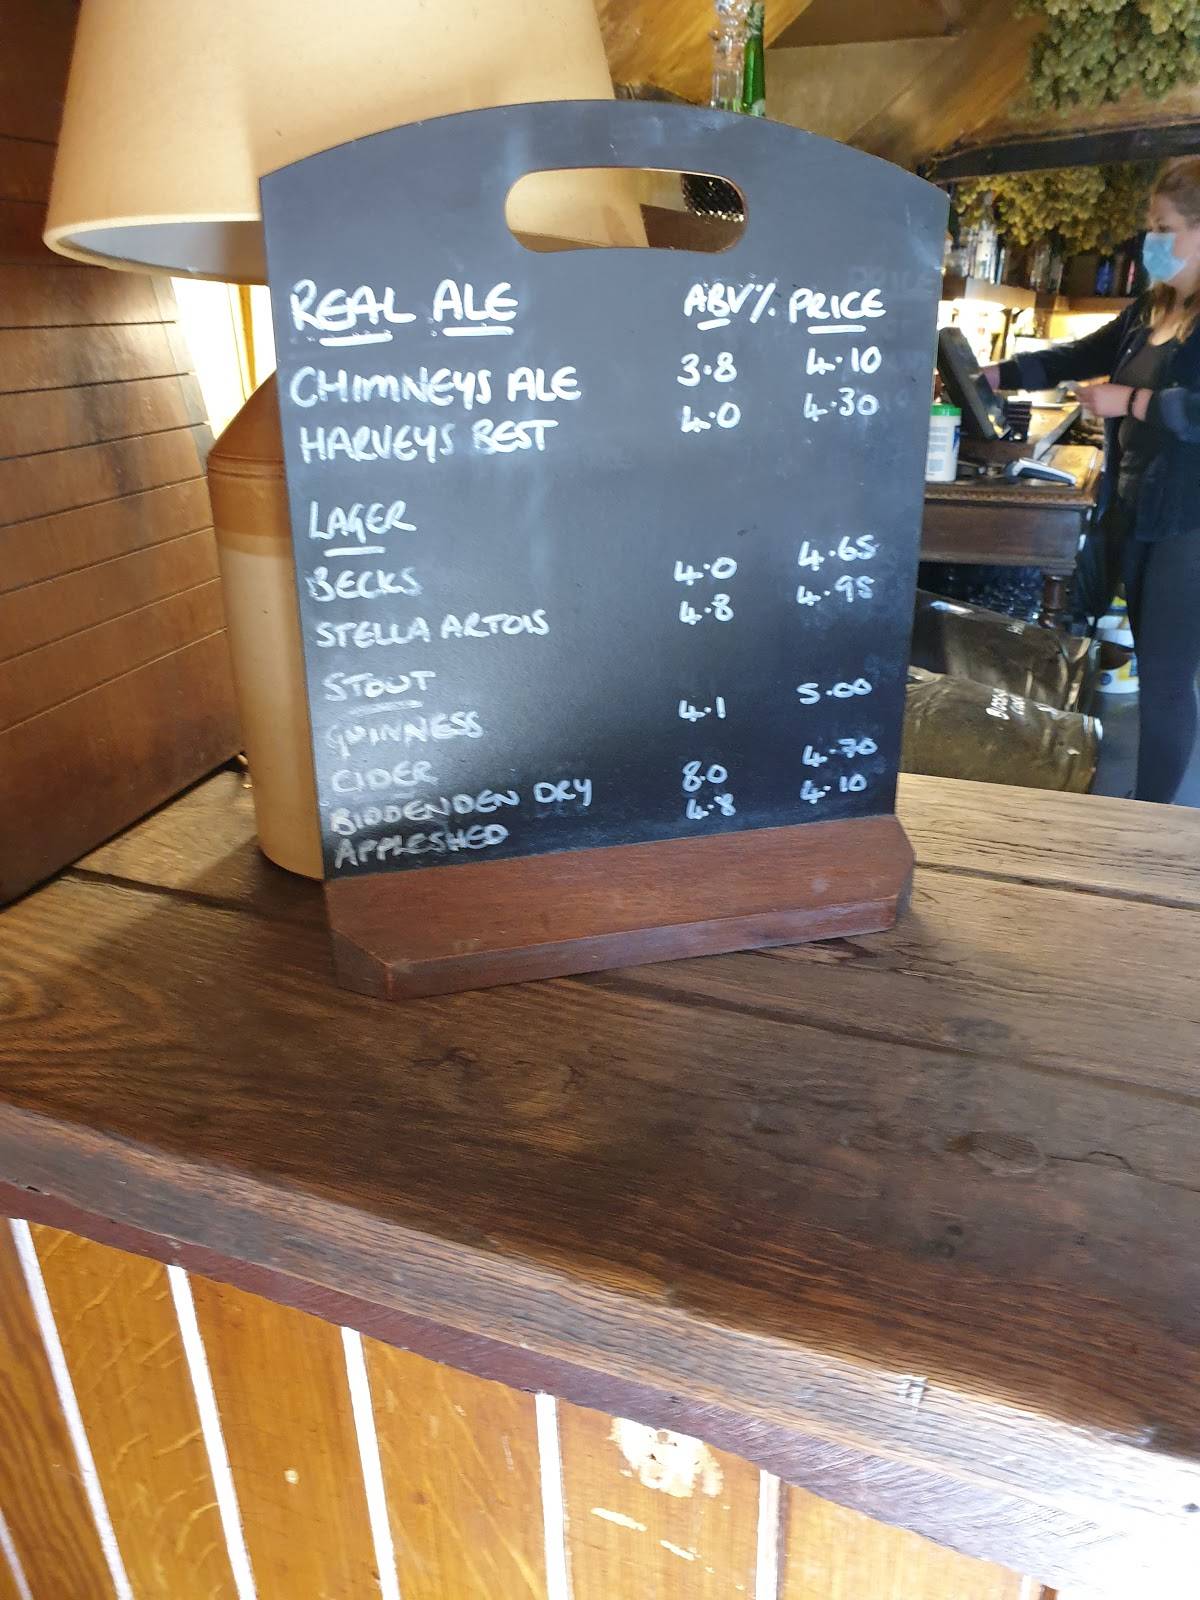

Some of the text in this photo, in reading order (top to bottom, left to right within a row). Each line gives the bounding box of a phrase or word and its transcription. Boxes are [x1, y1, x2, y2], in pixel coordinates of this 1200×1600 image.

[290, 279, 518, 331] REAL ALE
[789, 288, 886, 323] PRICE
[677, 352, 737, 386] 3.8
[806, 346, 882, 375] 4.10
[290, 366, 581, 410] CHIMNEYS ALE
[803, 387, 879, 421] 4.30
[681, 402, 741, 432] 4.0
[300, 418, 559, 463] HARVEYS BEST
[309, 500, 417, 543] LAGER
[798, 534, 877, 571] 4.65
[305, 566, 424, 602] BECKS
[674, 556, 738, 586] 4.0
[796, 575, 875, 606] 4.95
[679, 593, 734, 625] 4.8
[315, 609, 550, 648] STELLA ARTOIS
[322, 670, 436, 701] STOUT
[797, 678, 873, 705] 5.00
[678, 696, 726, 722] 4.1
[326, 711, 484, 760] GUINNESS
[332, 761, 439, 793] CIDER
[682, 760, 728, 792] 8.0
[800, 774, 868, 804] 4.10
[331, 779, 592, 836] BIDDENDEN DRY
[334, 824, 510, 869] APPLESHED
